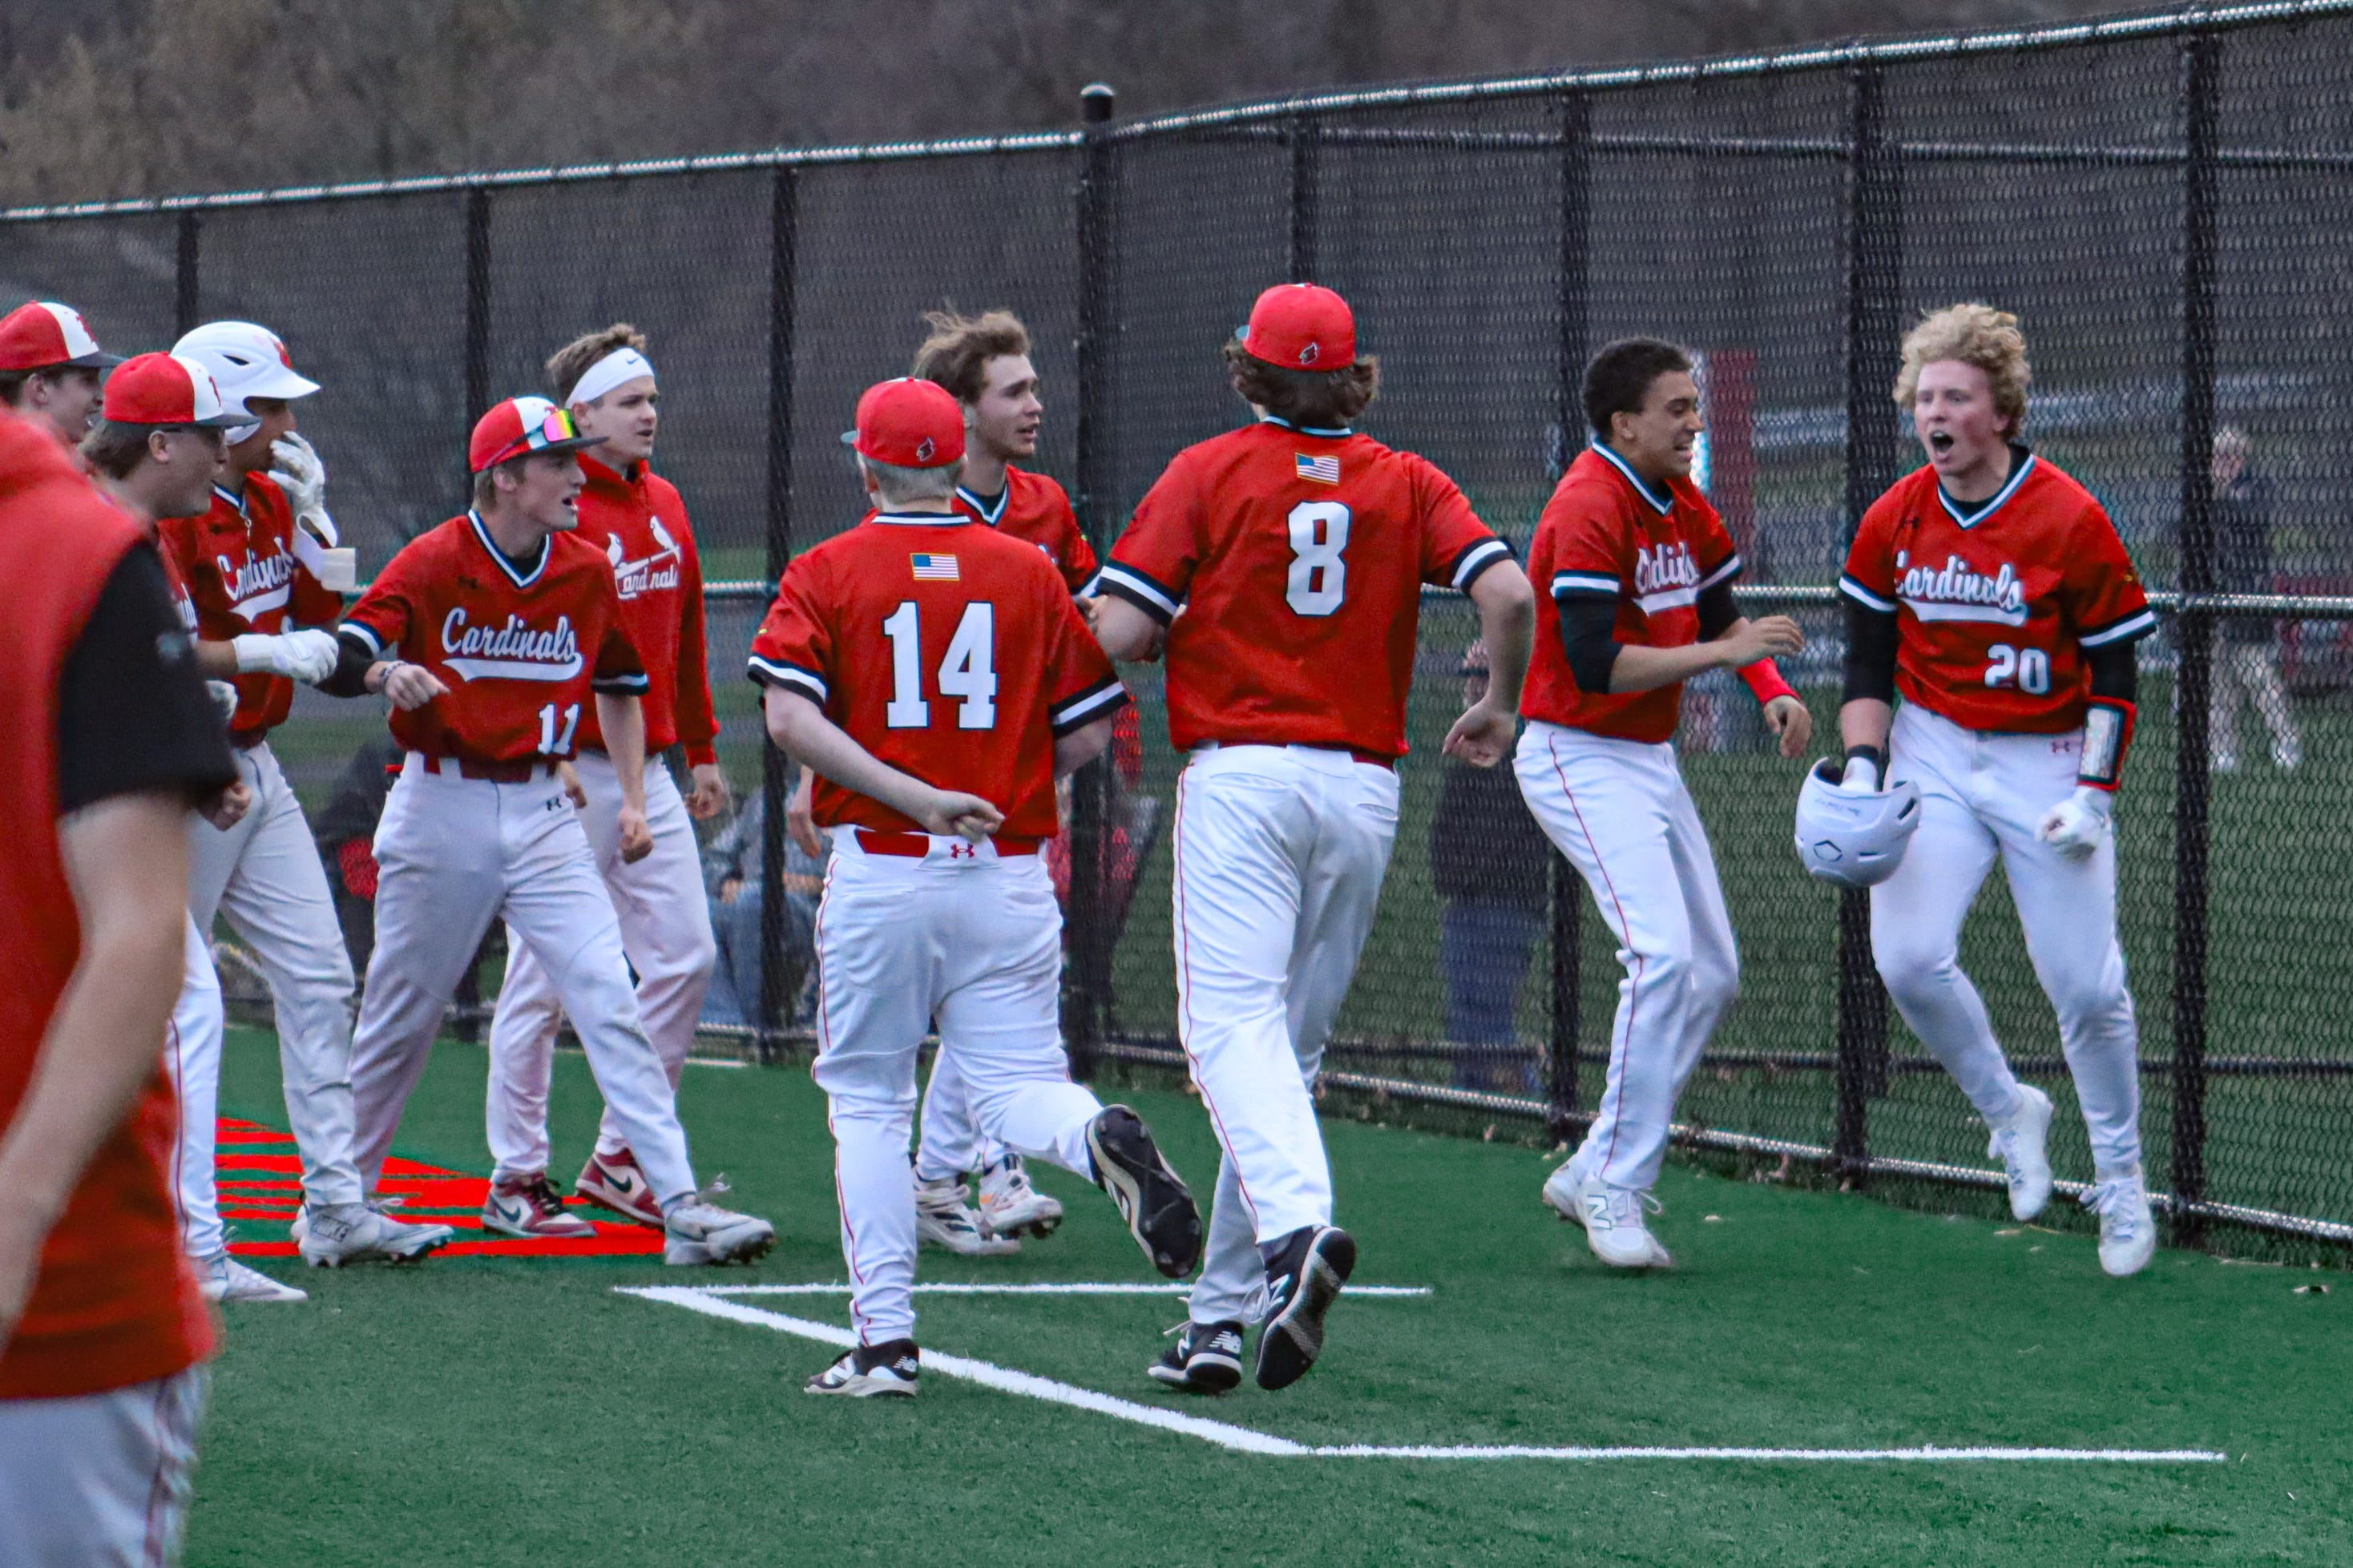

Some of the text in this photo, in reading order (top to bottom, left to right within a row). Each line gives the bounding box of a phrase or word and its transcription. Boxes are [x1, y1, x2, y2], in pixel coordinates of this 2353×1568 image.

[615, 564, 679, 599] Cardnals
[1285, 501, 1351, 616] 8
[442, 607, 579, 663] Cardinals
[883, 601, 998, 730] 14
[1984, 643, 2052, 695] 20
[538, 703, 580, 755] 11
